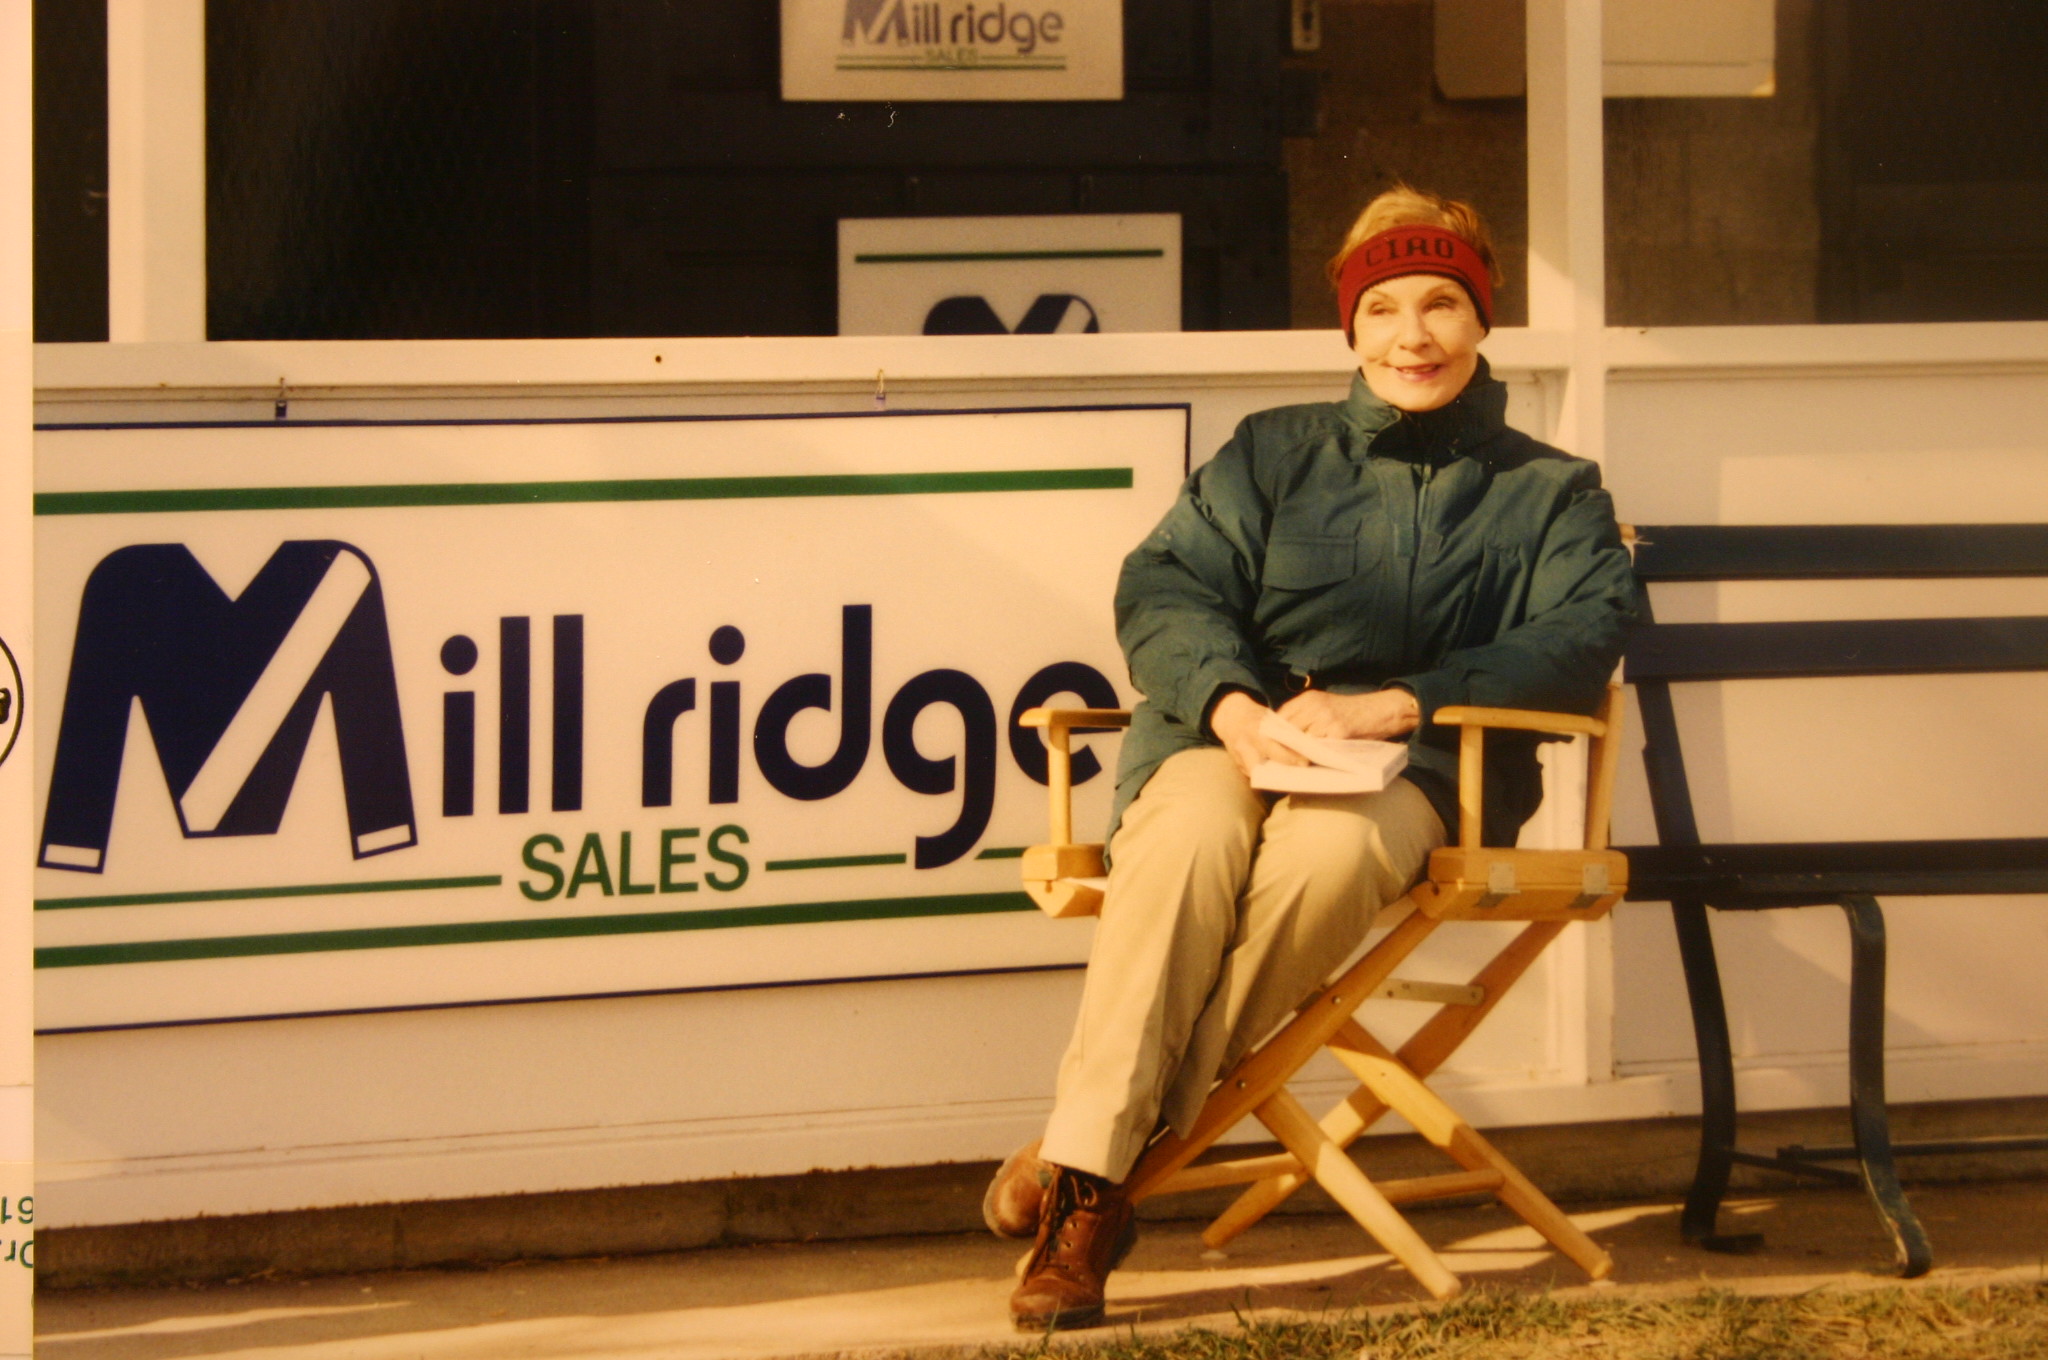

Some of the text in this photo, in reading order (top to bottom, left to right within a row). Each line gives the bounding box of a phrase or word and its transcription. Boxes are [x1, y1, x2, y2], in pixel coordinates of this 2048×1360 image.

[842, 0, 1064, 54] Mill ridge
[926, 48, 978, 65] SALES
[1365, 237, 1454, 267] CIAO
[37, 539, 584, 874] Mill
[518, 824, 750, 901] SALES
